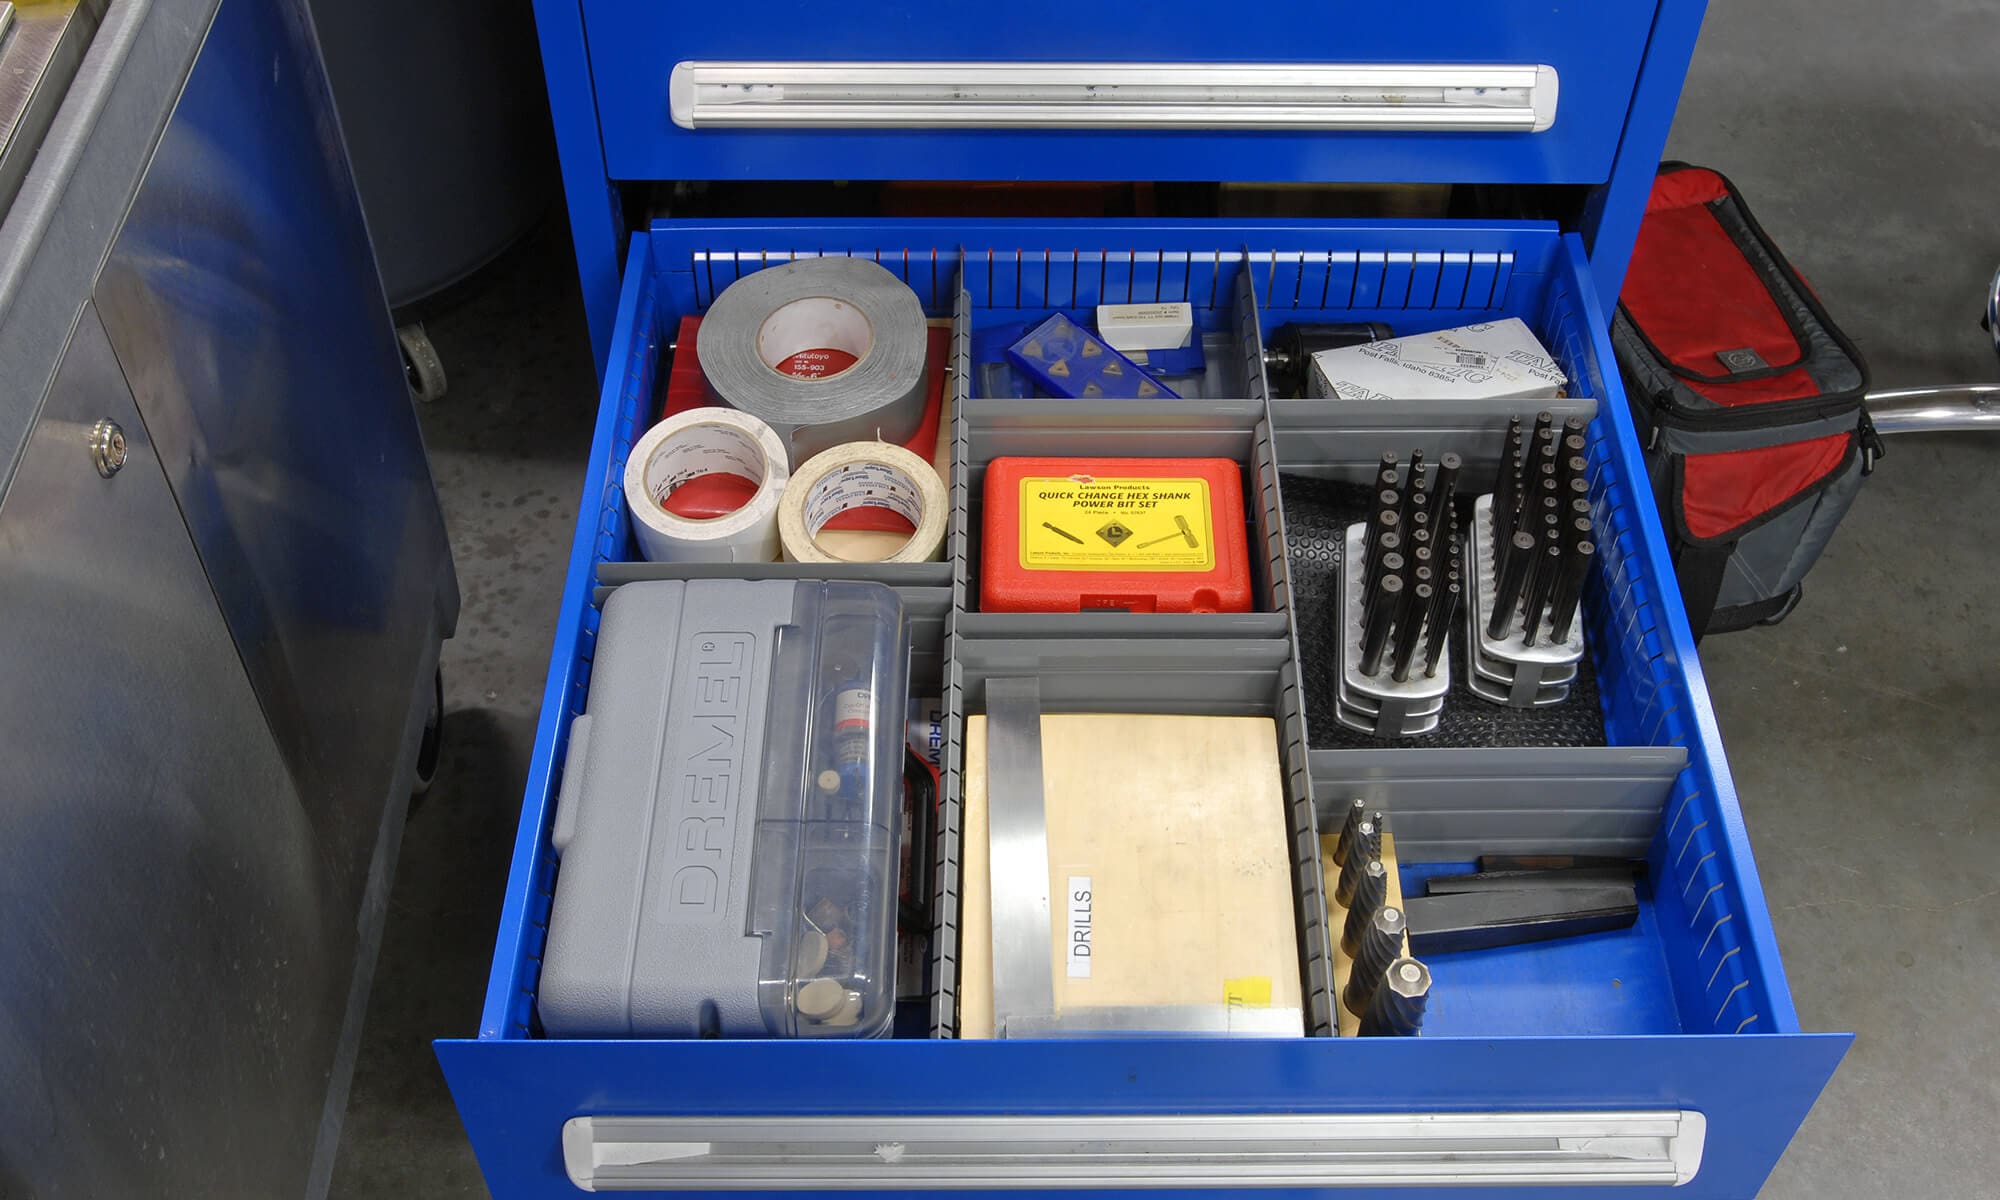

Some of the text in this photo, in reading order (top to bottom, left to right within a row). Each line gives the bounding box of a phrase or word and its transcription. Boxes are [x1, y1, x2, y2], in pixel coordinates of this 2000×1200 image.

[1359, 347, 1379, 359] Post
[1402, 362, 1428, 375] Idaho
[1528, 368, 1549, 381] Post
[1039, 491, 1191, 500] QUICK CHANGE HEX SHANK
[1073, 500, 1114, 508] POWER
[1117, 500, 1136, 508] BIT
[929, 710, 943, 765] DREM
[669, 641, 745, 913] DREMEL
[1073, 890, 1092, 957] DRILLS
